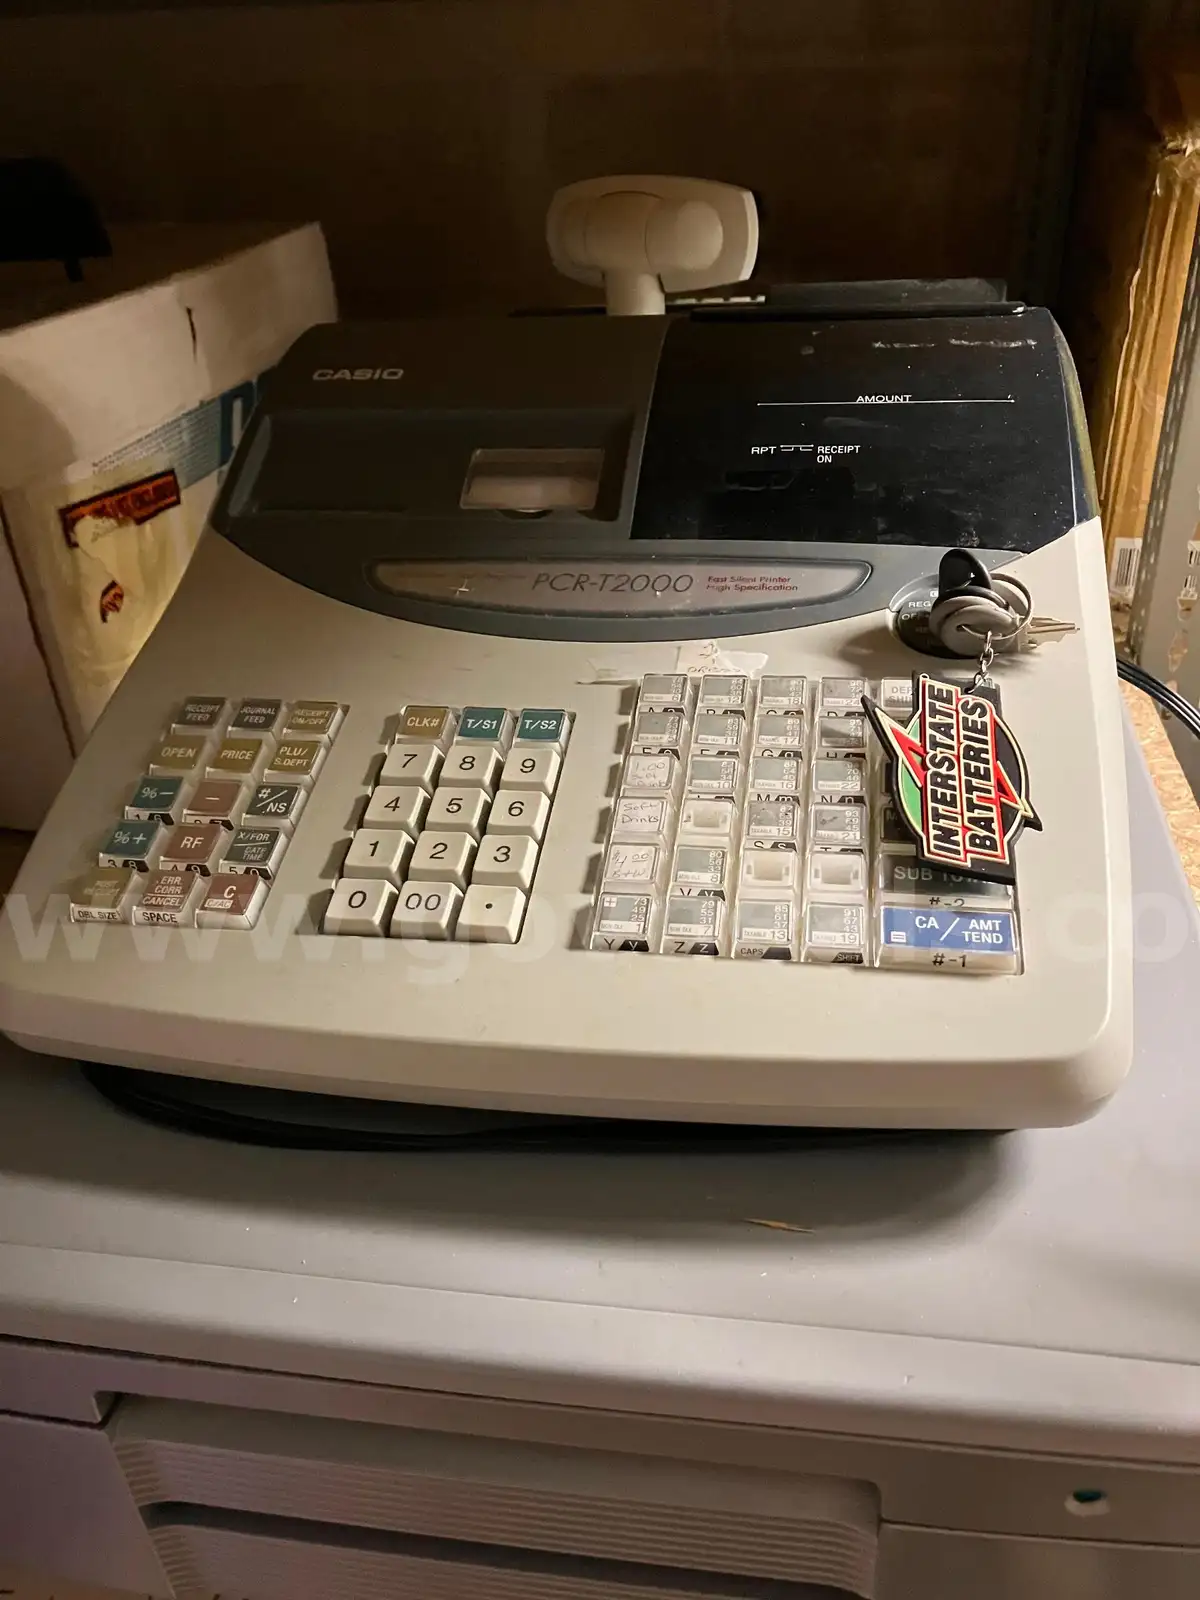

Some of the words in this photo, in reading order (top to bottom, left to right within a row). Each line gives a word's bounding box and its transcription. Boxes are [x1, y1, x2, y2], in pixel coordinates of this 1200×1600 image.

[312, 368, 404, 381] CASIO
[855, 394, 913, 404] AMOUNT
[751, 446, 776, 454] RPT
[817, 444, 860, 454] RECEIPT
[817, 454, 832, 464] ON
[532, 572, 694, 594] PCR-T2000
[734, 582, 798, 592] Specification
[908, 600, 932, 608] REG
[892, 686, 912, 694] DEP
[185, 704, 220, 713] RECEIPT
[240, 706, 276, 715] JOURNAL
[244, 715, 266, 724] FEED
[406, 716, 439, 728] CLK#
[466, 718, 498, 730] T/S1
[524, 720, 558, 730] T/S2
[162, 746, 197, 758] OPEN
[220, 749, 255, 760] PRICE
[279, 746, 308, 757] PLU/
[273, 758, 309, 766] S.DEPT
[401, 753, 418, 769] 7
[459, 755, 476, 770] 8
[520, 758, 536, 774] 9
[928, 683, 962, 857] INTERSTATE
[961, 698, 998, 854] BATTERIES
[780, 782, 794, 790] 16
[840, 782, 858, 790] 22
[384, 796, 400, 812] 4
[446, 798, 463, 814] 5
[508, 800, 524, 817] 6
[621, 814, 660, 824] Drinks
[845, 810, 859, 818] 93
[237, 831, 270, 842] X/FOR
[776, 828, 790, 836] 15
[841, 832, 857, 840] 21
[180, 836, 204, 848] RF
[369, 840, 380, 857] 1
[429, 842, 448, 860] 2
[492, 845, 511, 862] 3
[710, 874, 719, 882] 8
[894, 867, 932, 880] SUB
[154, 886, 182, 894] CORR
[224, 885, 236, 899] C
[142, 896, 182, 906] CANCEL
[348, 890, 367, 909] 0
[404, 892, 442, 911] 00
[634, 898, 648, 906] 73
[702, 900, 715, 908] 79
[631, 906, 646, 914] 49
[774, 905, 788, 913] 85
[843, 908, 858, 917] 91
[98, 912, 118, 920] SIZE
[142, 912, 178, 924] SPACE
[630, 914, 645, 922] 25
[700, 916, 712, 924] 31
[774, 913, 788, 921] 61
[843, 917, 858, 925] 67
[773, 921, 788, 929] 37
[915, 916, 940, 930] CA
[968, 919, 1002, 931] AMT
[636, 924, 643, 934] 1
[704, 926, 712, 935] 7
[770, 930, 786, 940] 13
[840, 934, 858, 944] 19
[961, 930, 1004, 944] TEND
[604, 938, 616, 950] Y
[674, 942, 686, 954] Z
[740, 948, 764, 956] CAPS
[838, 954, 860, 962] SHIFT
